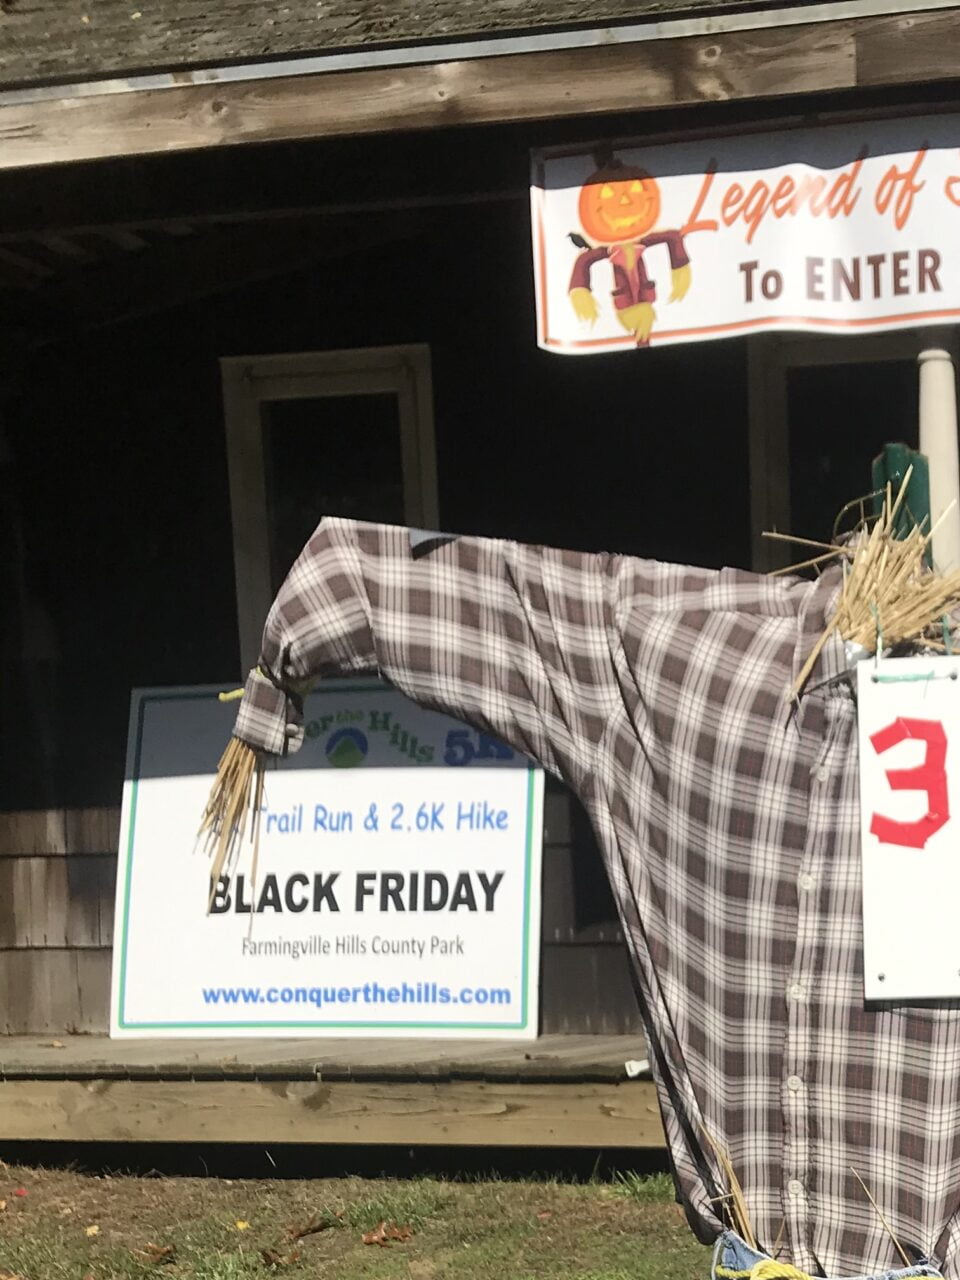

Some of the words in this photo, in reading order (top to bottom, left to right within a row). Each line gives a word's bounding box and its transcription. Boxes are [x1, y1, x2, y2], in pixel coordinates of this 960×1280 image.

[681, 143, 870, 244] Legend
[877, 141, 930, 231] of
[739, 260, 784, 303] To
[805, 248, 943, 302] ENTER
[335, 709, 365, 724] the
[367, 709, 436, 764] Hills
[869, 716, 951, 849] 3
[259, 803, 303, 834] rail
[313, 803, 353, 832] Run
[363, 802, 379, 832] &
[390, 801, 445, 832] 2.6K
[455, 800, 510, 831] Hike
[209, 872, 340, 914] BLACK
[355, 871, 506, 913] FRIDAY
[241, 937, 331, 959] Farmingville
[335, 936, 367, 954] Hills
[371, 936, 426, 958] County
[430, 935, 465, 955] Park
[202, 982, 512, 1009] www.conquerthehills.com
